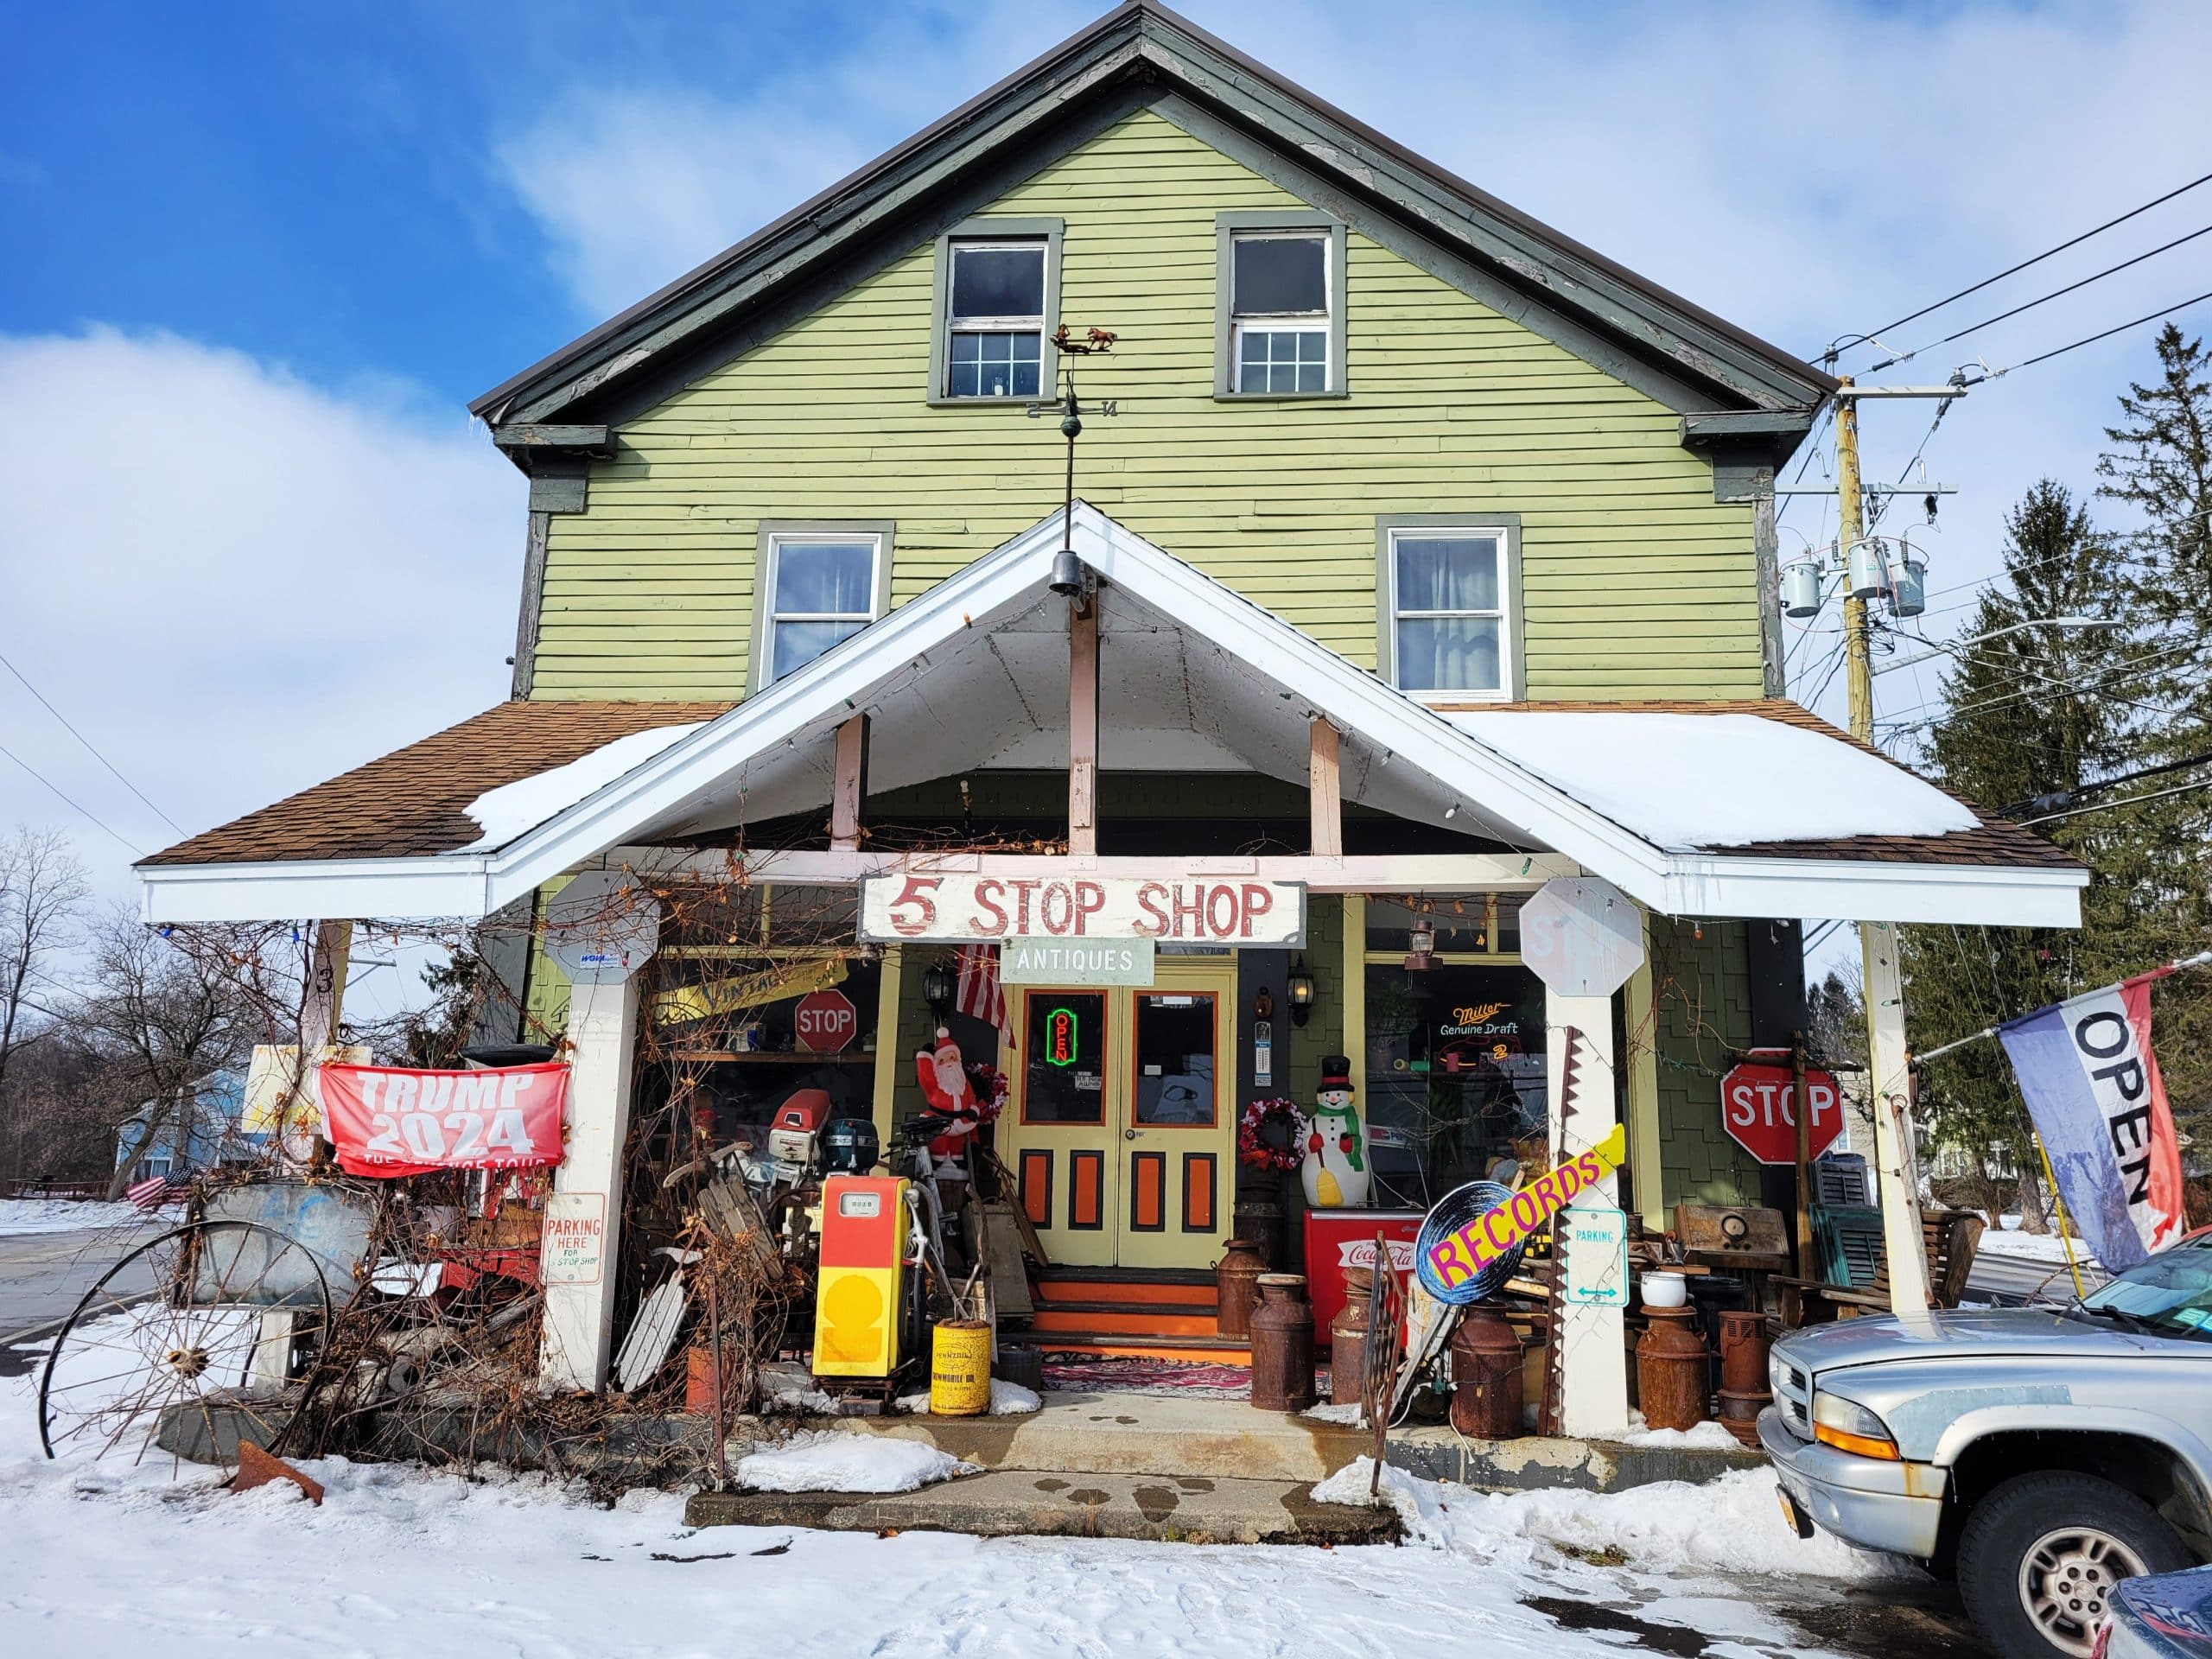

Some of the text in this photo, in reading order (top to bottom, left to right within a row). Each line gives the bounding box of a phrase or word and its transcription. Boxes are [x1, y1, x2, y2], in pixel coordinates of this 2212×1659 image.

[889, 875, 1274, 938] 5 STOP SHOP
[1016, 949, 1134, 972] ANTIQUES
[315, 969, 334, 993] 3
[815, 966, 838, 987] SALE
[799, 1009, 851, 1033] STOP
[1452, 1002, 1505, 1026] Miller
[1056, 1014, 1068, 1062] OPEN
[1440, 1022, 1519, 1035] Genuine Draft
[1492, 1044, 1508, 1060] 2
[356, 1071, 535, 1113] TRUMP
[2075, 1011, 2152, 1205] OPEN
[367, 1109, 535, 1160] 2024
[547, 1218, 601, 1236] PARKING
[1428, 1151, 1600, 1290] RECORDS
[557, 1237, 587, 1249] HERE
[1575, 1230, 1614, 1243] PARKING
[557, 1257, 580, 1266] STOP
[580, 1256, 599, 1265] SHOP
[1348, 1244, 1412, 1266] Cocaola
